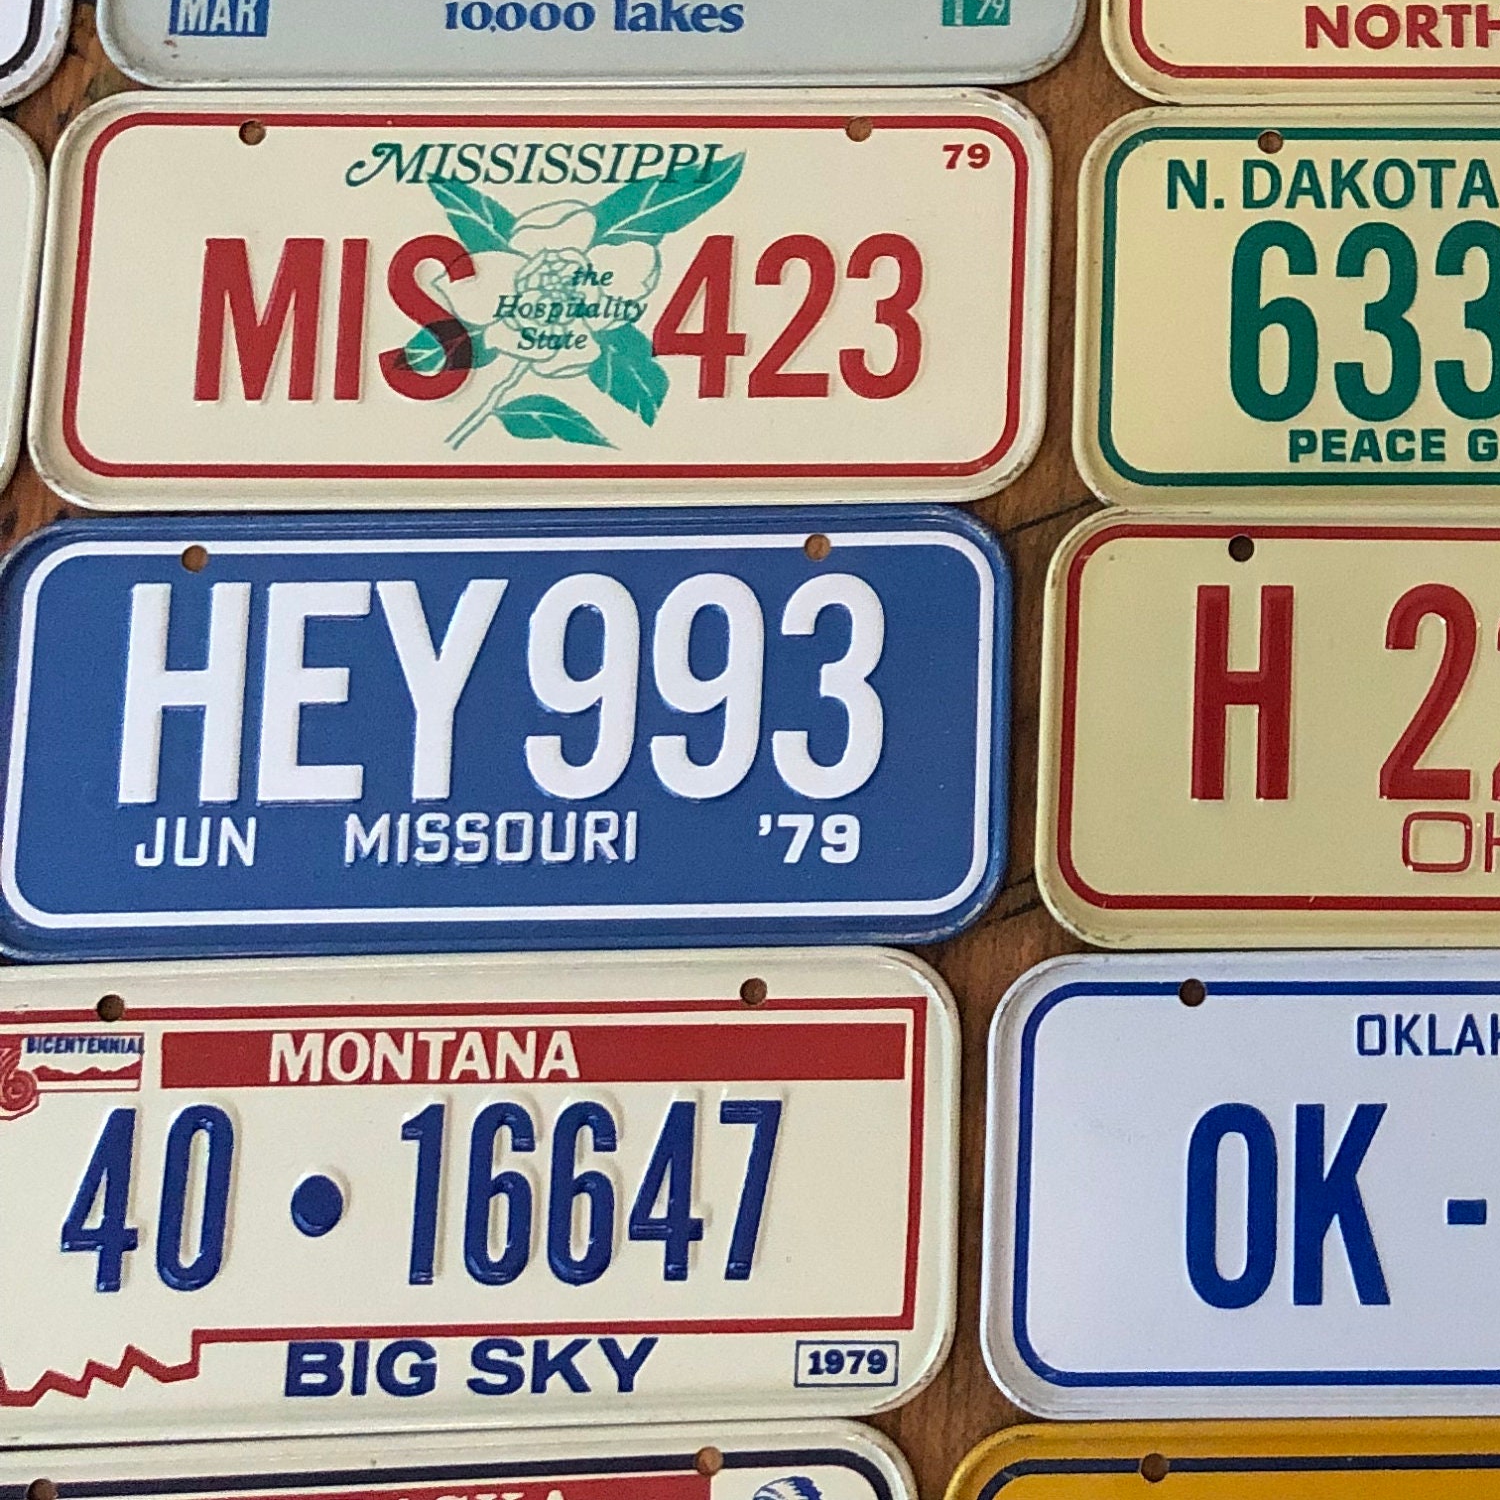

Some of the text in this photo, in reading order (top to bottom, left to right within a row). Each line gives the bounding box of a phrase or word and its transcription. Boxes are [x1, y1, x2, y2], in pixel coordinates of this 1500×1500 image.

[446, 2, 595, 32] 10,000
[346, 142, 724, 188] MISSISSIPPI
[943, 144, 990, 169] 79
[1168, 159, 1499, 209] N. DAKOTA
[572, 264, 613, 288] the
[195, 235, 923, 402] MIS 423
[493, 295, 646, 322] Hospitality
[516, 327, 587, 351] State
[1289, 429, 1446, 463] PEACE
[1191, 585, 1294, 800] H
[135, 811, 860, 866] JUN MISSOURI '79
[270, 1030, 580, 1083] MONTANA
[61, 1100, 782, 1292] 40 16647
[284, 1337, 659, 1397] BIG SKY
[809, 1349, 887, 1375] 1979
